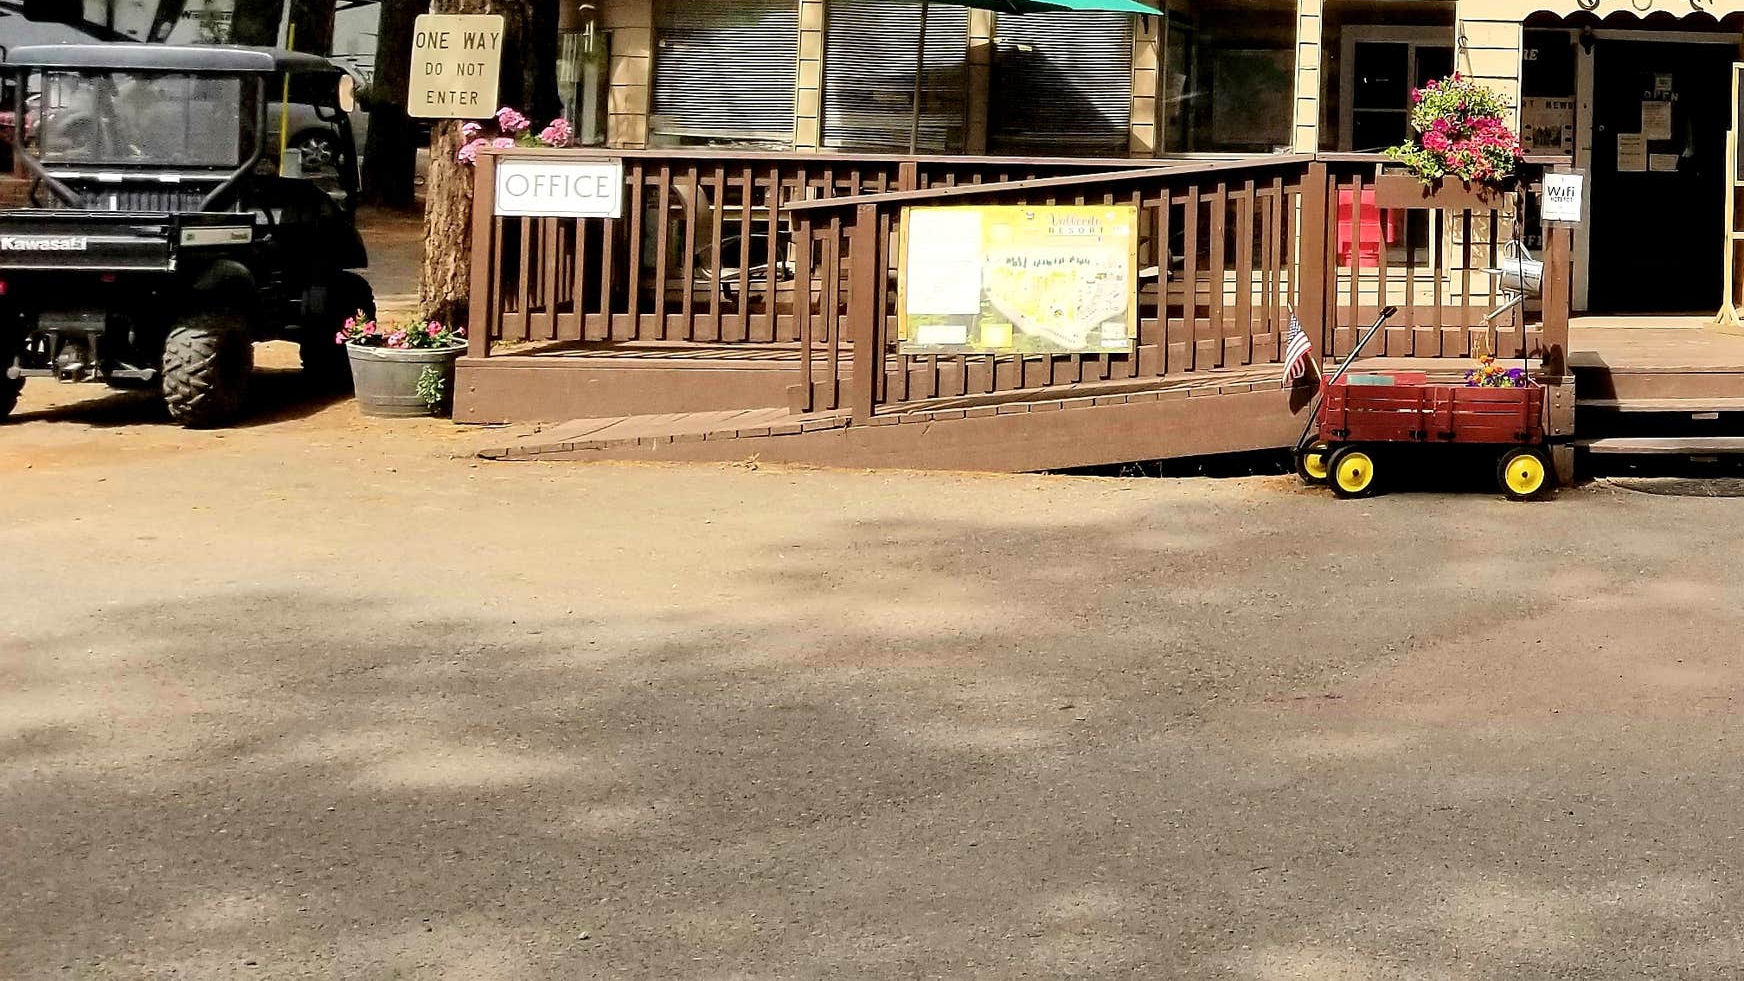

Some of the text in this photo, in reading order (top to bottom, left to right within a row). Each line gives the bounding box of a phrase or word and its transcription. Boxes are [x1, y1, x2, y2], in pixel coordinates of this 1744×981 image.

[415, 31, 500, 50] ONE WAY
[425, 62, 485, 76] DO NOT
[426, 90, 478, 105] ENTER
[1643, 90, 1679, 102] OPEN
[505, 173, 610, 198] OFFICE
[1, 237, 87, 251] Kawasaki
